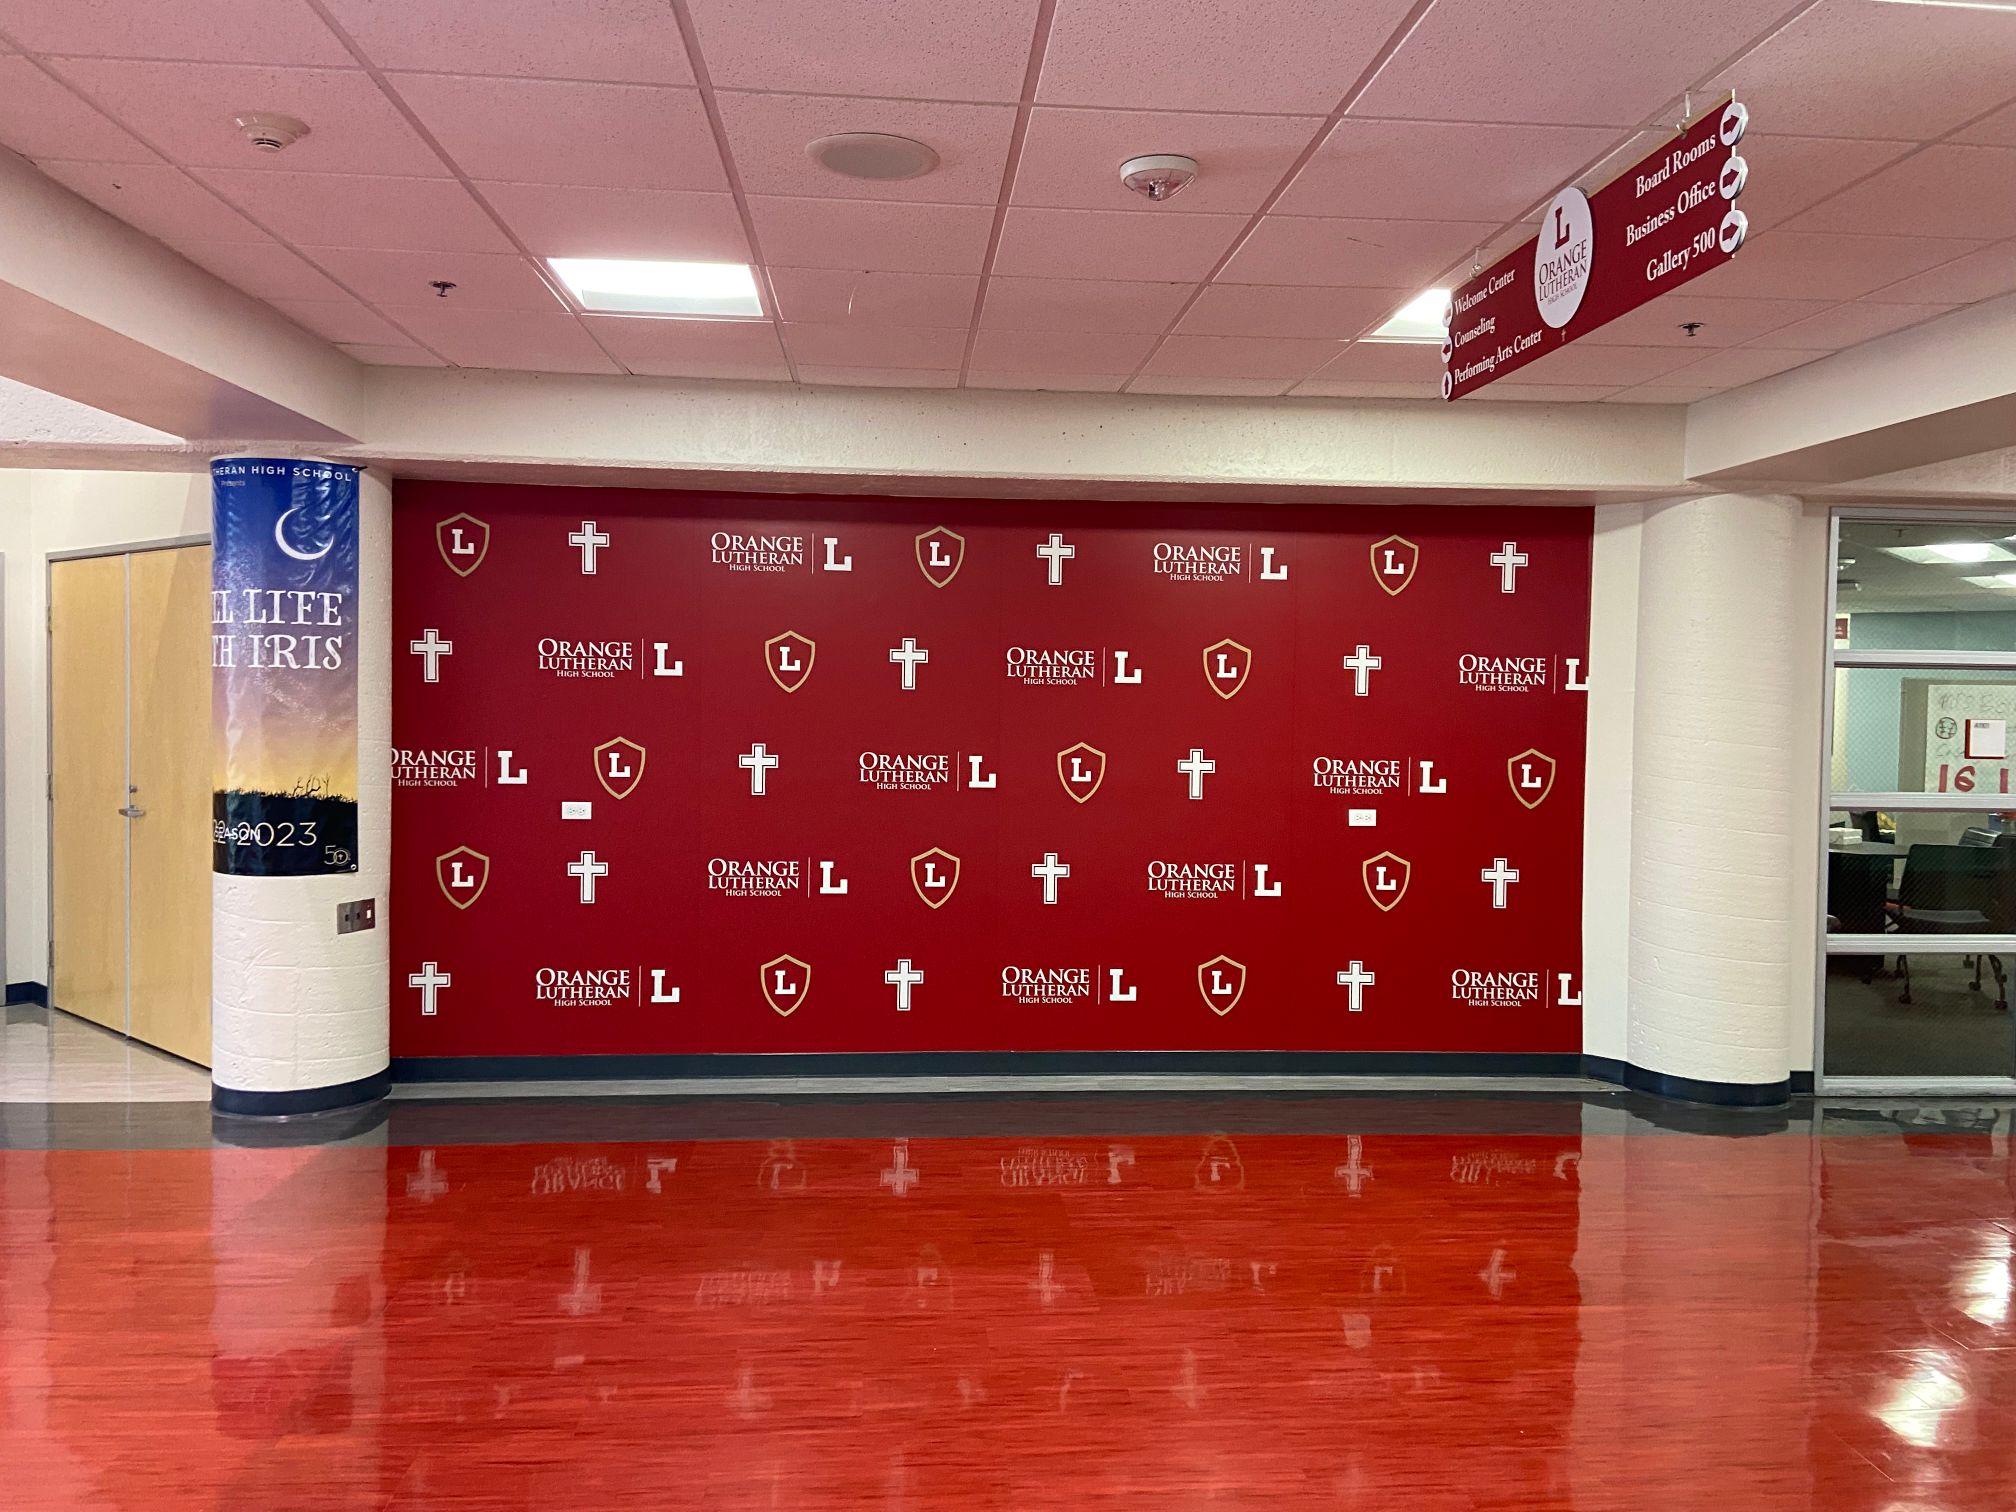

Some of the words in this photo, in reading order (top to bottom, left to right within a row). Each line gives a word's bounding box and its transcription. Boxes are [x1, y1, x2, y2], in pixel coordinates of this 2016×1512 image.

[1635, 156, 1671, 198] Board
[1672, 134, 1716, 174] Rooms
[1625, 205, 1675, 247] Business
[1677, 181, 1716, 214] Office
[1554, 206, 1570, 250] L
[1538, 239, 1587, 286] ORANGE
[1646, 249, 1692, 281] Gallery
[1692, 227, 1715, 258] 500
[1454, 286, 1488, 316] Welcome
[1488, 269, 1516, 294] Center
[1539, 259, 1588, 302] LUTHERAN
[1454, 316, 1496, 348] Counseling
[1454, 355, 1496, 385] Performing
[1494, 345, 1513, 365] Arts
[1513, 329, 1543, 354] Center
[251, 465, 286, 476] HIGH
[292, 467, 352, 482] SCHOOL
[452, 529, 474, 554] L
[711, 532, 803, 552] ORANGE
[1154, 543, 1240, 562] ORANGE
[711, 551, 803, 565] LUTHERAN
[824, 538, 852, 571] L
[930, 542, 950, 566] L
[1260, 547, 1287, 580] L
[1384, 550, 1404, 574] L
[1154, 560, 1240, 574] LUTHERAN
[243, 588, 342, 626] LIFE
[248, 633, 342, 671] IRIS
[538, 638, 632, 657] ORANGE
[654, 643, 683, 676] L
[780, 647, 800, 671] L
[1007, 647, 1094, 666] ORANGE
[539, 656, 632, 670] LUTHERAN
[1007, 664, 1094, 678] LUTHERAN
[1115, 651, 1141, 683] L
[1217, 654, 1237, 678] L
[1459, 654, 1545, 672] ORANGE
[1565, 659, 1588, 690] L
[1459, 670, 1545, 685] LUTHERAN
[391, 766, 475, 778] UTHERAN
[498, 751, 527, 784] L
[609, 753, 630, 777] L
[859, 752, 948, 770] ORANGE
[969, 756, 996, 788] L
[1071, 758, 1091, 782] L
[1314, 757, 1400, 775] ORANGE
[860, 769, 948, 782] LUTHERAN
[1314, 773, 1400, 787] LUTHERAN
[1420, 761, 1446, 793] L
[1521, 764, 1541, 788] L
[452, 862, 473, 887] L
[708, 858, 799, 876] ORANGE
[820, 861, 848, 894] L
[925, 863, 945, 887] L
[1148, 860, 1234, 879] ORANGE
[1376, 867, 1396, 890] L
[709, 875, 799, 889] LUTHERAN
[1148, 877, 1234, 891] LUTHERAN
[1255, 864, 1281, 896] L
[536, 967, 629, 986] ORANGE
[651, 970, 680, 1002] L
[775, 970, 796, 994] L
[1002, 966, 1089, 984] ORANGE
[1110, 969, 1136, 1001] L
[1212, 971, 1231, 994] L
[1452, 969, 1538, 987] ORANGE
[537, 985, 629, 999] LUTHERAN
[1002, 983, 1089, 996] LUTHERAN
[1453, 985, 1538, 999] LUTHERAN
[1558, 973, 1582, 1005] L
